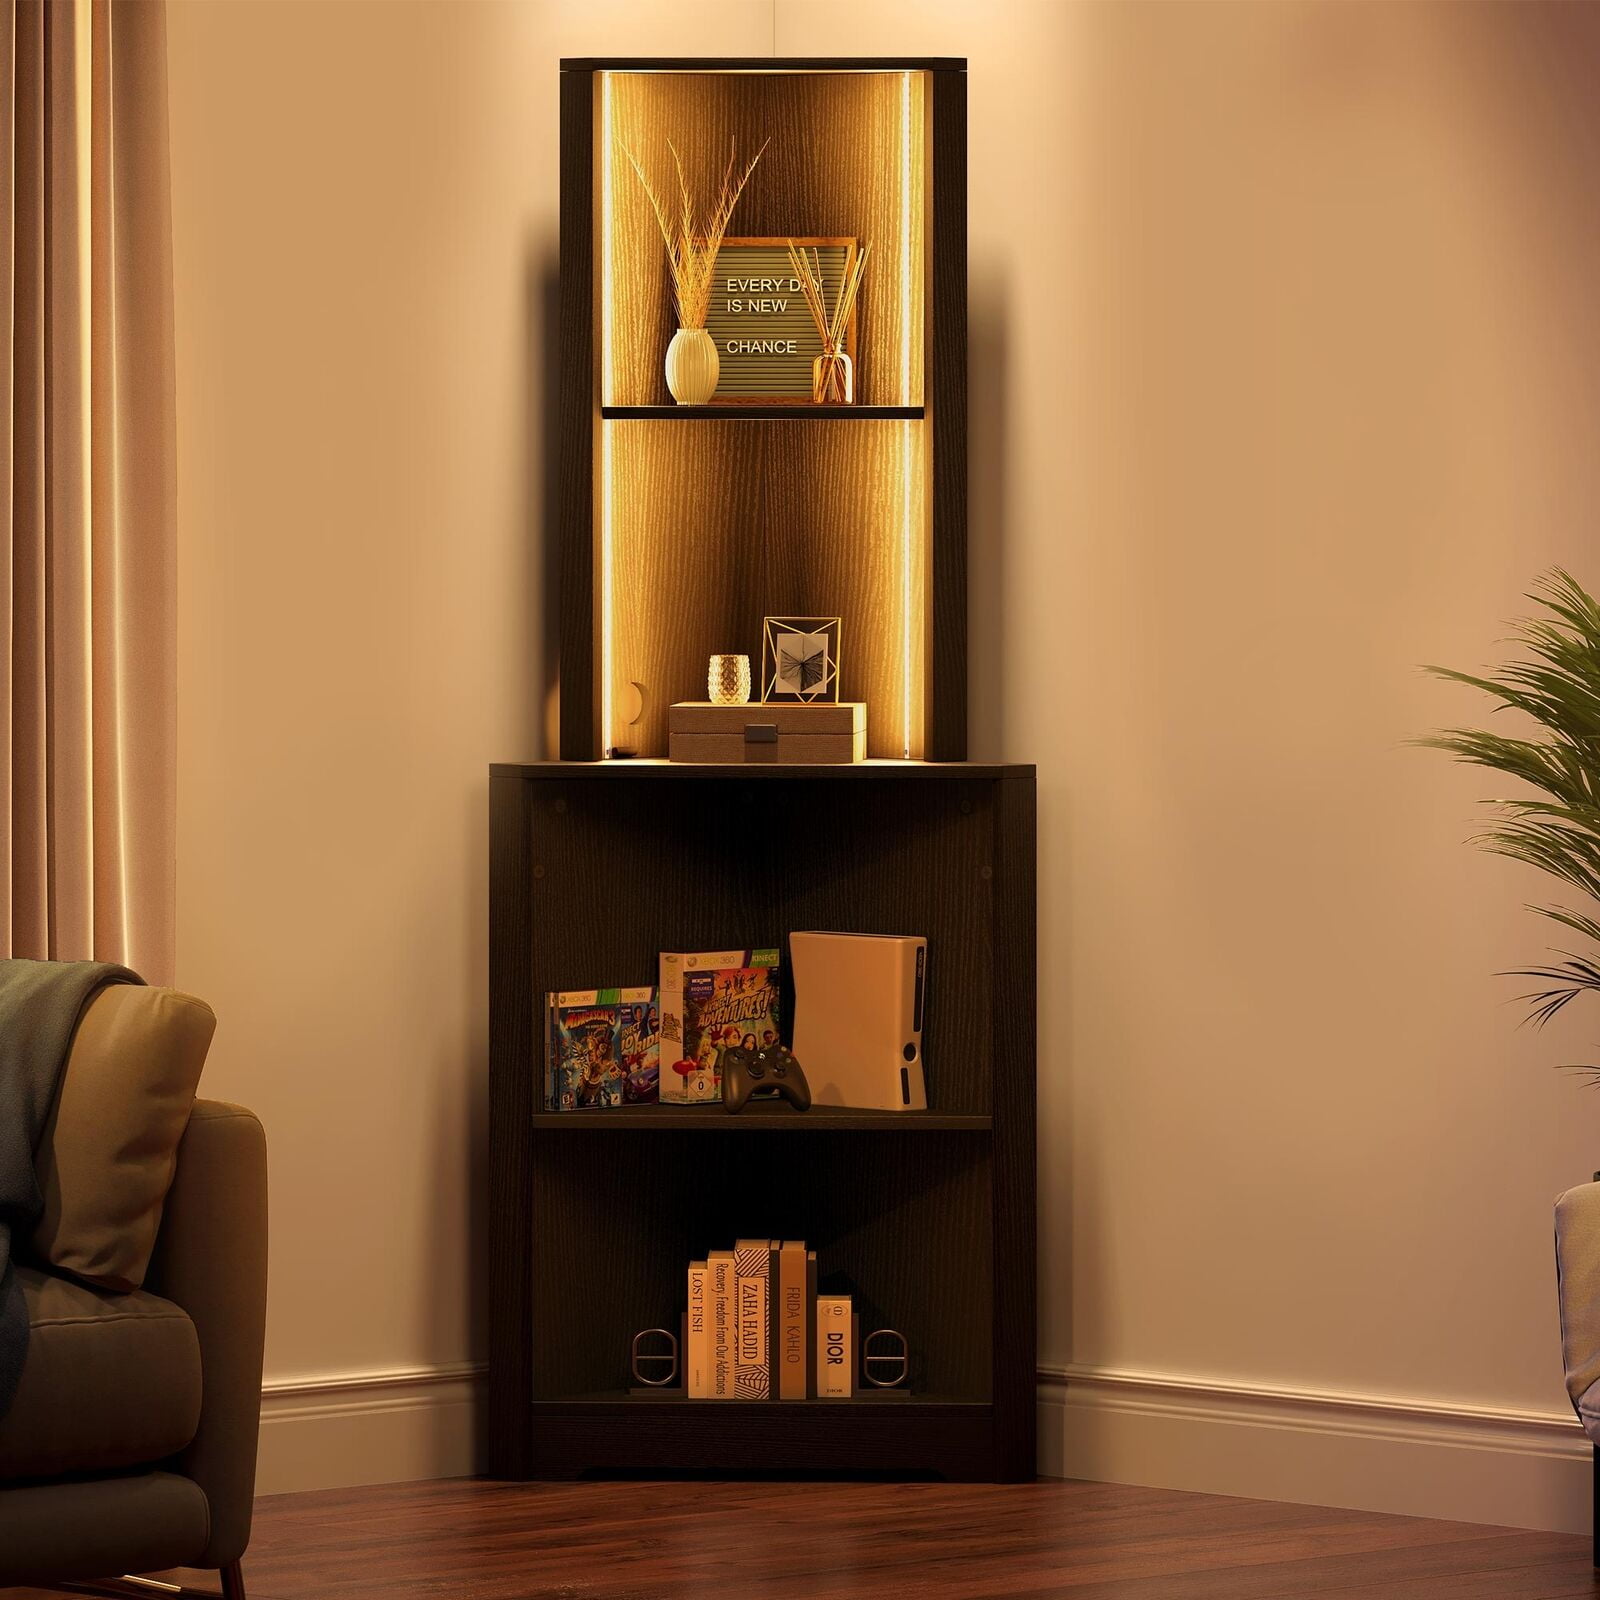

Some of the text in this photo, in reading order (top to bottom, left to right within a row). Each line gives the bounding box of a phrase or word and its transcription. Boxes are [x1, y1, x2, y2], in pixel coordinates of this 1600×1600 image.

[727, 279, 784, 292] EVERY
[727, 299, 787, 312] IS NEW
[726, 340, 797, 353] CHANCE
[752, 954, 778, 962] KINECT
[699, 985, 772, 1028] ADVENTURES!
[698, 1081, 704, 1090] 0
[692, 1272, 703, 1332] LOST FISH
[716, 1296, 730, 1325] Freedom
[742, 1284, 758, 1359] ZAHA HADID
[786, 1287, 801, 1363] FRIDA KAHLO
[716, 1327, 729, 1344] From
[716, 1345, 729, 1359] Our
[827, 1333, 844, 1365] DIOR
[716, 1359, 730, 1395] Addictions
